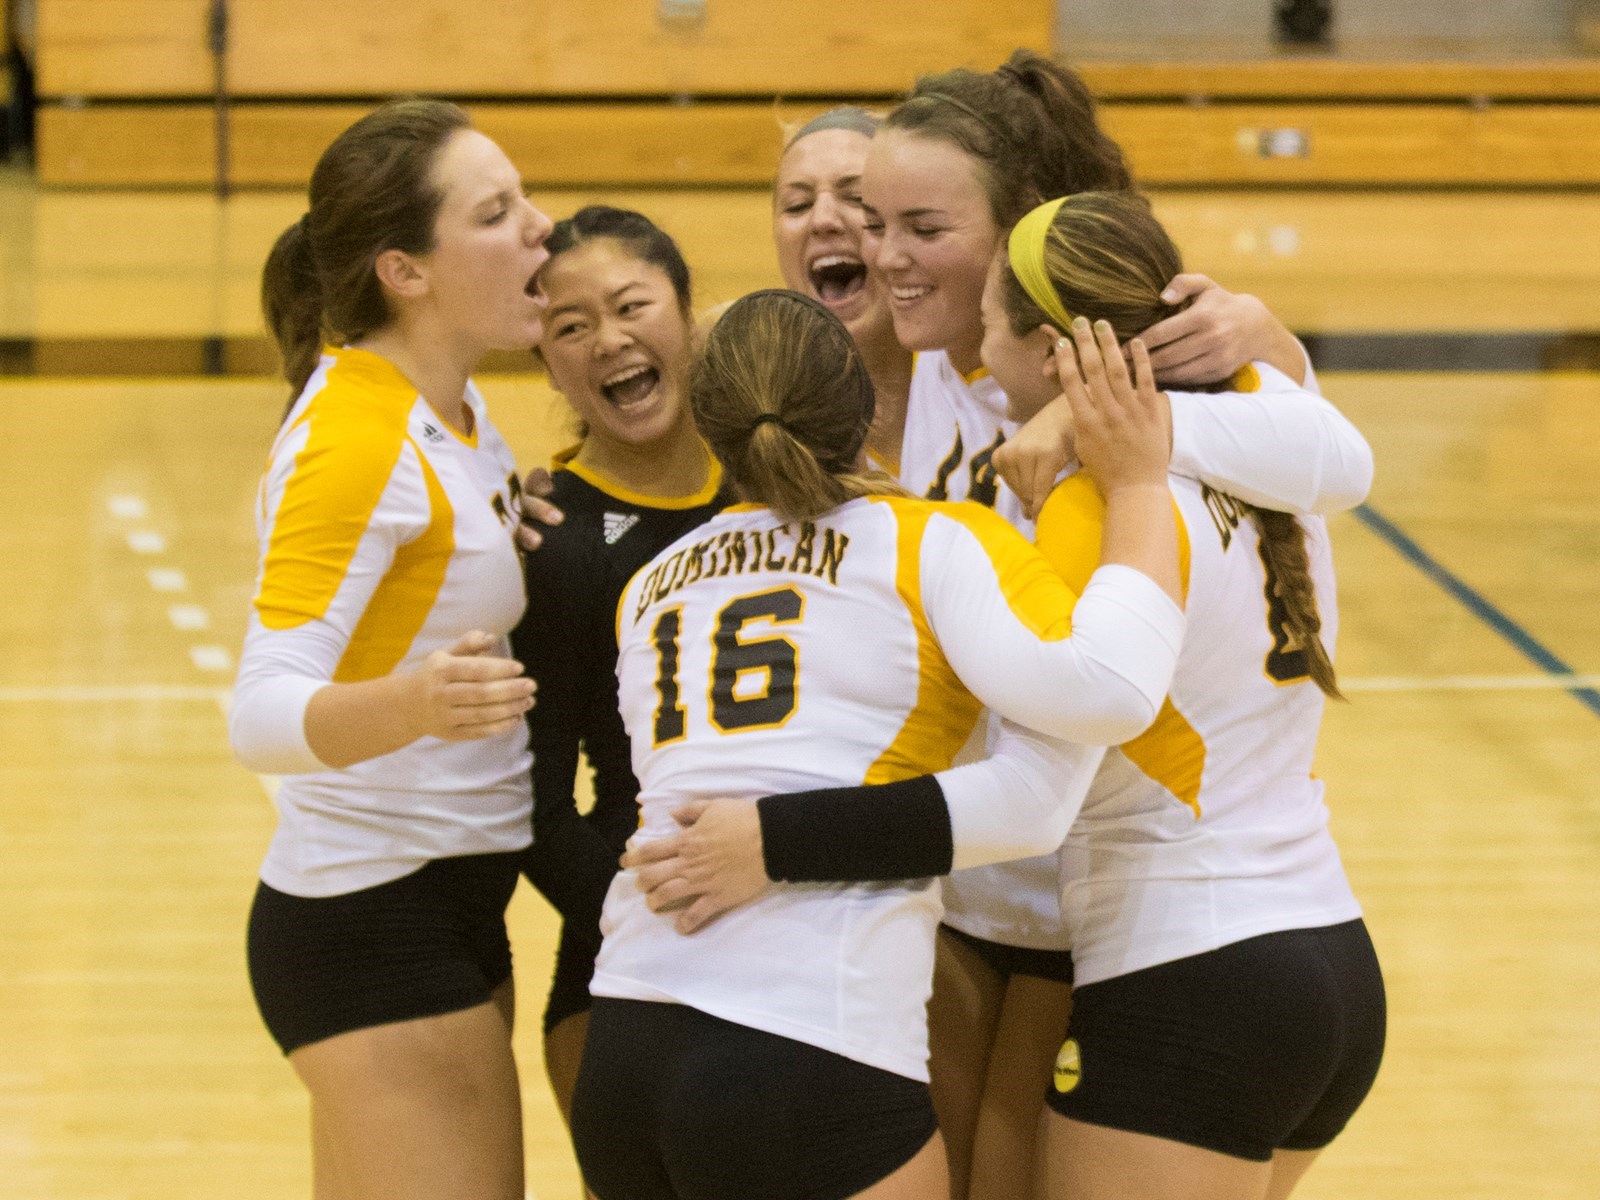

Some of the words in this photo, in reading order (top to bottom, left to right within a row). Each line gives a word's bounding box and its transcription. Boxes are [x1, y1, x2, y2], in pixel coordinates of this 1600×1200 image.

[604, 514, 640, 544] adidas
[634, 521, 850, 628] DOMINICAN
[648, 583, 807, 750] 16
